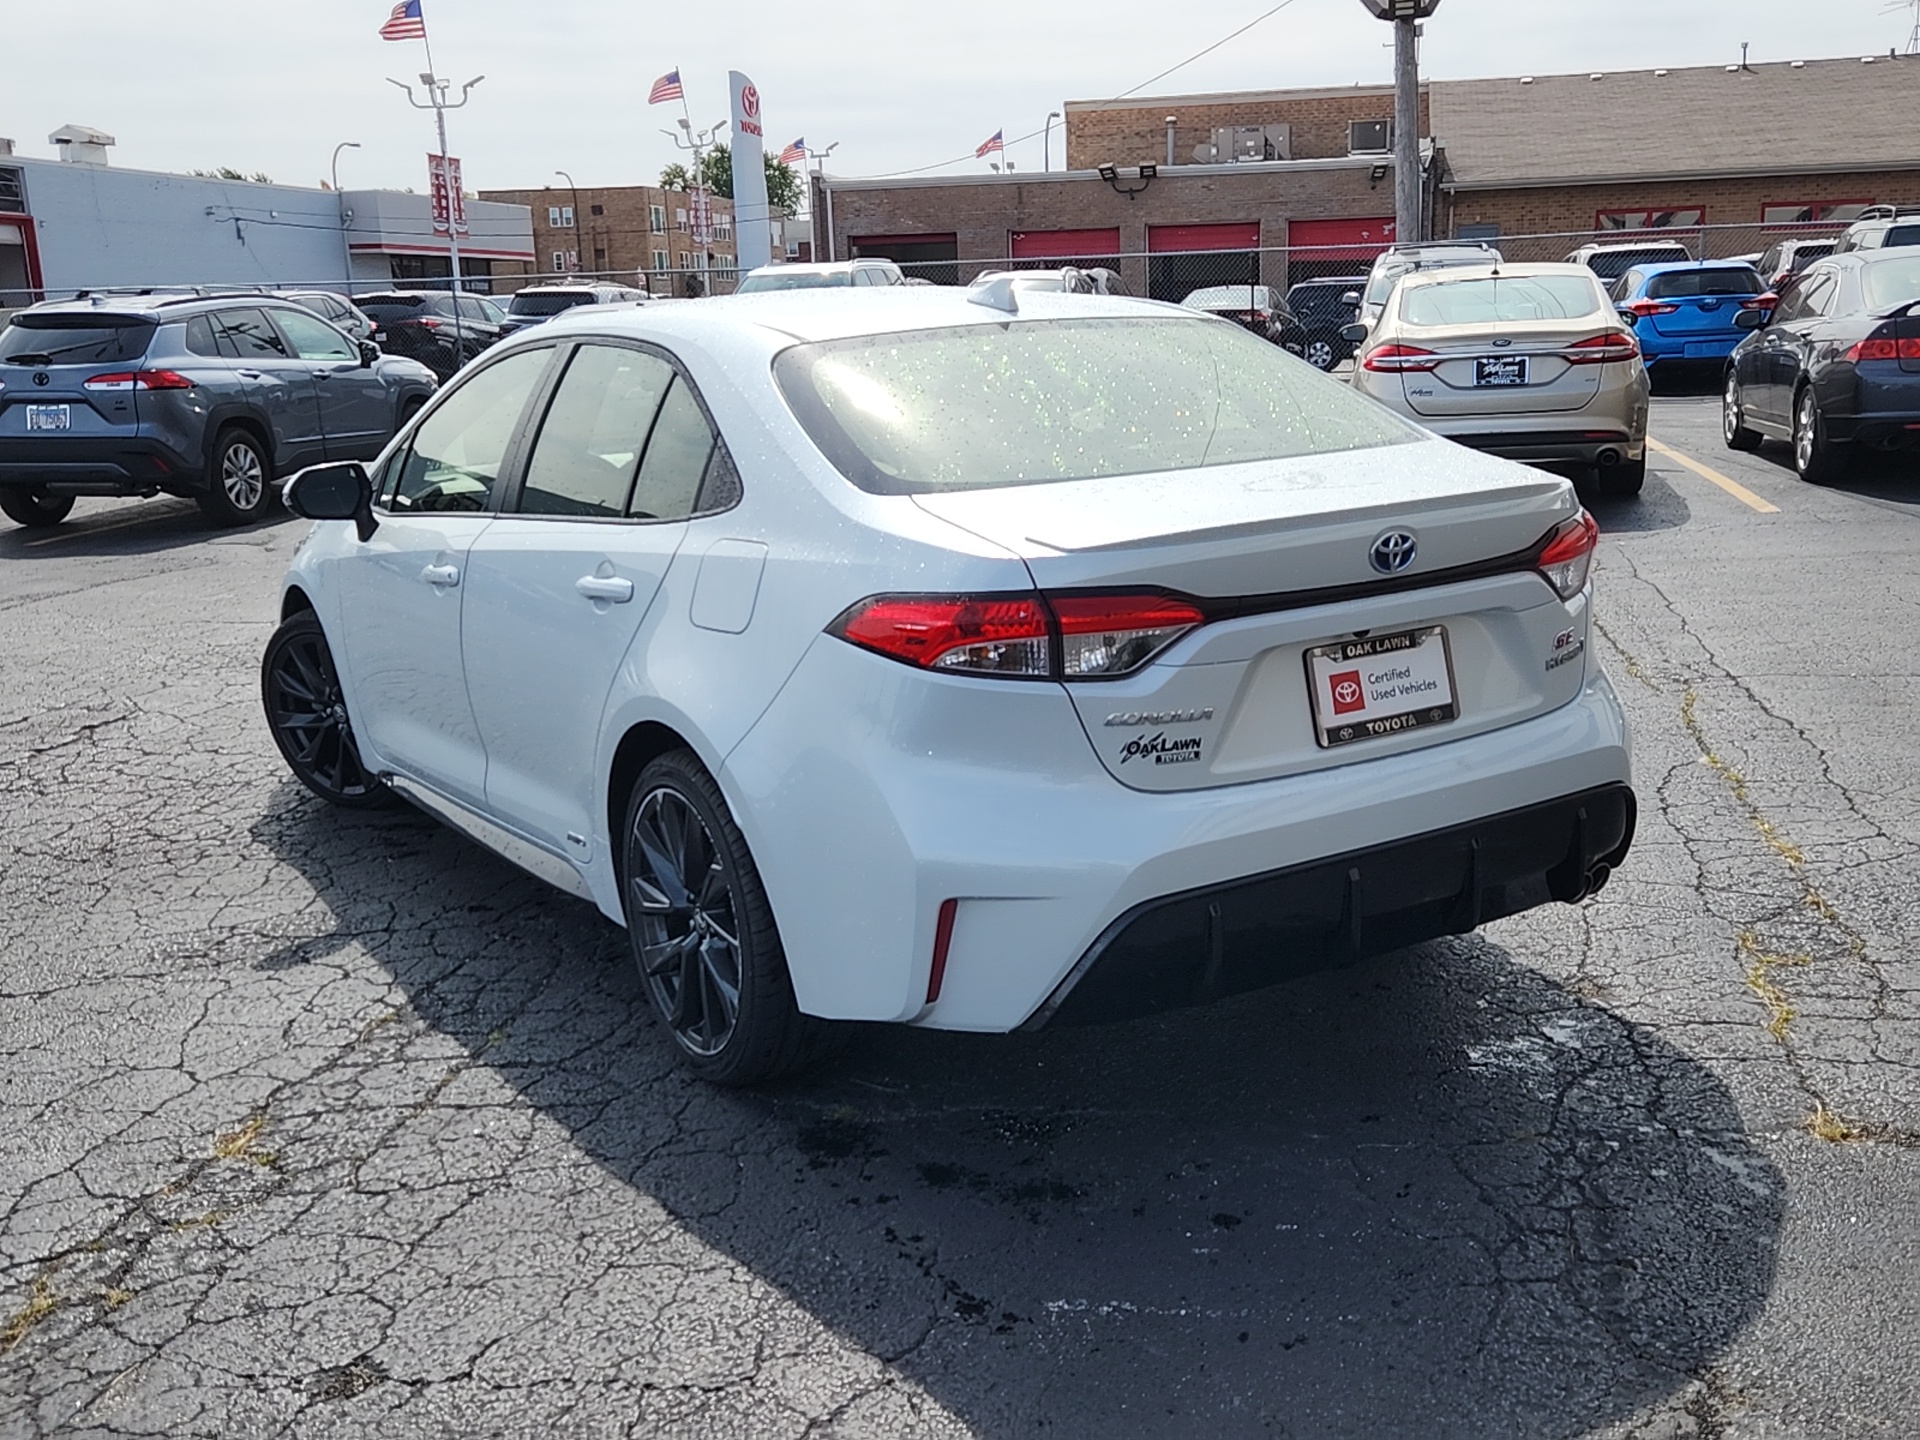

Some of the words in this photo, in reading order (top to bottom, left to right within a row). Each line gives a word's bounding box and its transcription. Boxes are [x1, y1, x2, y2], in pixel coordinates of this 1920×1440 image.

[1346, 643, 1372, 657] OAK
[1376, 635, 1410, 652] LAWN
[1368, 666, 1411, 685] Certified
[1370, 685, 1396, 701] Used
[1398, 679, 1438, 698] Vehicles
[1103, 707, 1214, 727] COROLLA
[1365, 714, 1417, 735] TOYOTA
[1159, 751, 1197, 764] TOYOTA
